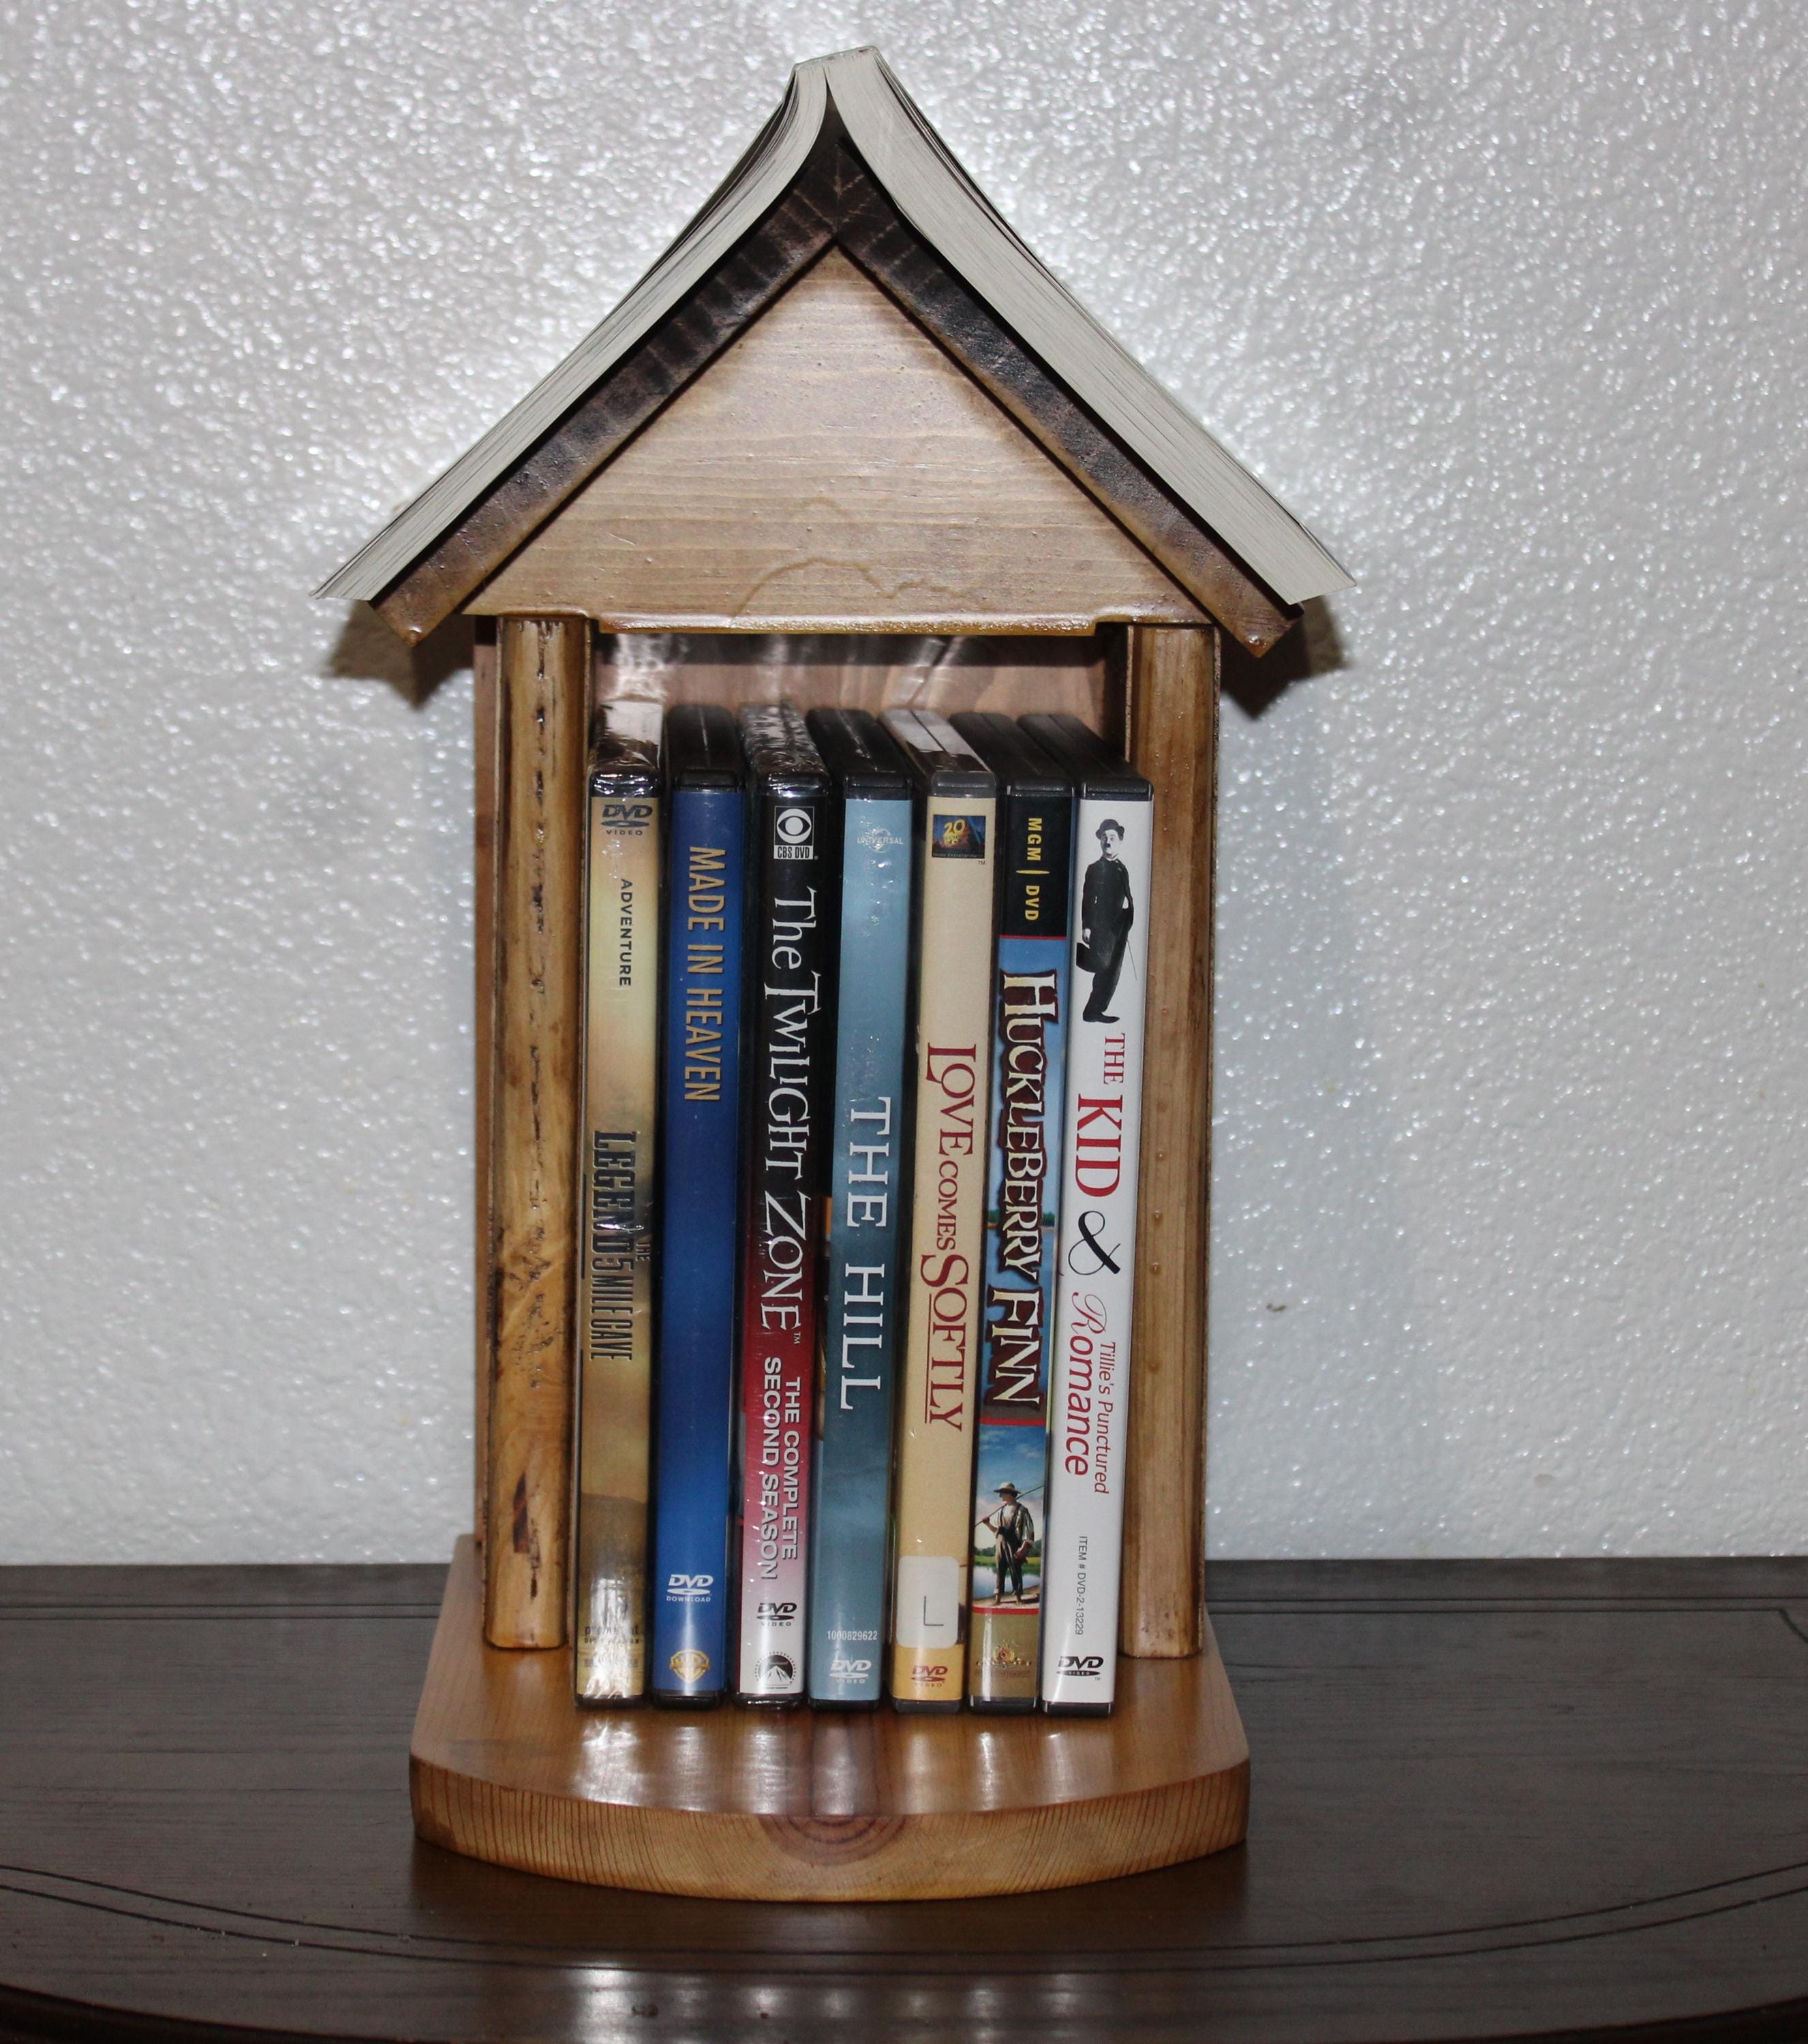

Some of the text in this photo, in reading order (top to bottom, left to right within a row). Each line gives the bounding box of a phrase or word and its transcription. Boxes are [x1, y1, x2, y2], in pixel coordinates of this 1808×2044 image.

[602, 805, 653, 820] DVD
[778, 846, 810, 858] CBS DVD
[857, 836, 904, 845] UNIVERSAL
[1025, 818, 1043, 920] MGM DVD
[619, 879, 632, 986] ADVENTURE
[684, 846, 726, 1101] MADE IN HEAVEN
[772, 886, 817, 970] The
[764, 971, 822, 1180] TWILIGHT
[992, 972, 1057, 1404] HUCKLEBERRY FINN
[1068, 1033, 1126, 1275] THE KID &
[589, 1131, 636, 1361] LEGEND 5 MILE CAVE
[761, 1190, 811, 1330] ZONE
[840, 1096, 891, 1410] THE HILL
[921, 1042, 977, 1431] LOVE COMES SOFTLY
[1065, 1291, 1107, 1476] Romance
[1094, 1342, 1116, 1493] Tillie's Punctured
[761, 1357, 782, 1579] SECOND SEASON
[782, 1376, 801, 1560] THE COMPLETE
[668, 1574, 714, 1589] DVD
[1078, 1536, 1088, 1560] ITEM
[758, 1602, 797, 1615] DVD
[827, 1630, 878, 1641] 1000829622
[1075, 1573, 1086, 1635] DVD-2-13229
[831, 1660, 872, 1672] DVD
[912, 1665, 948, 1676] DVD
[1058, 1656, 1104, 1669] DVD
